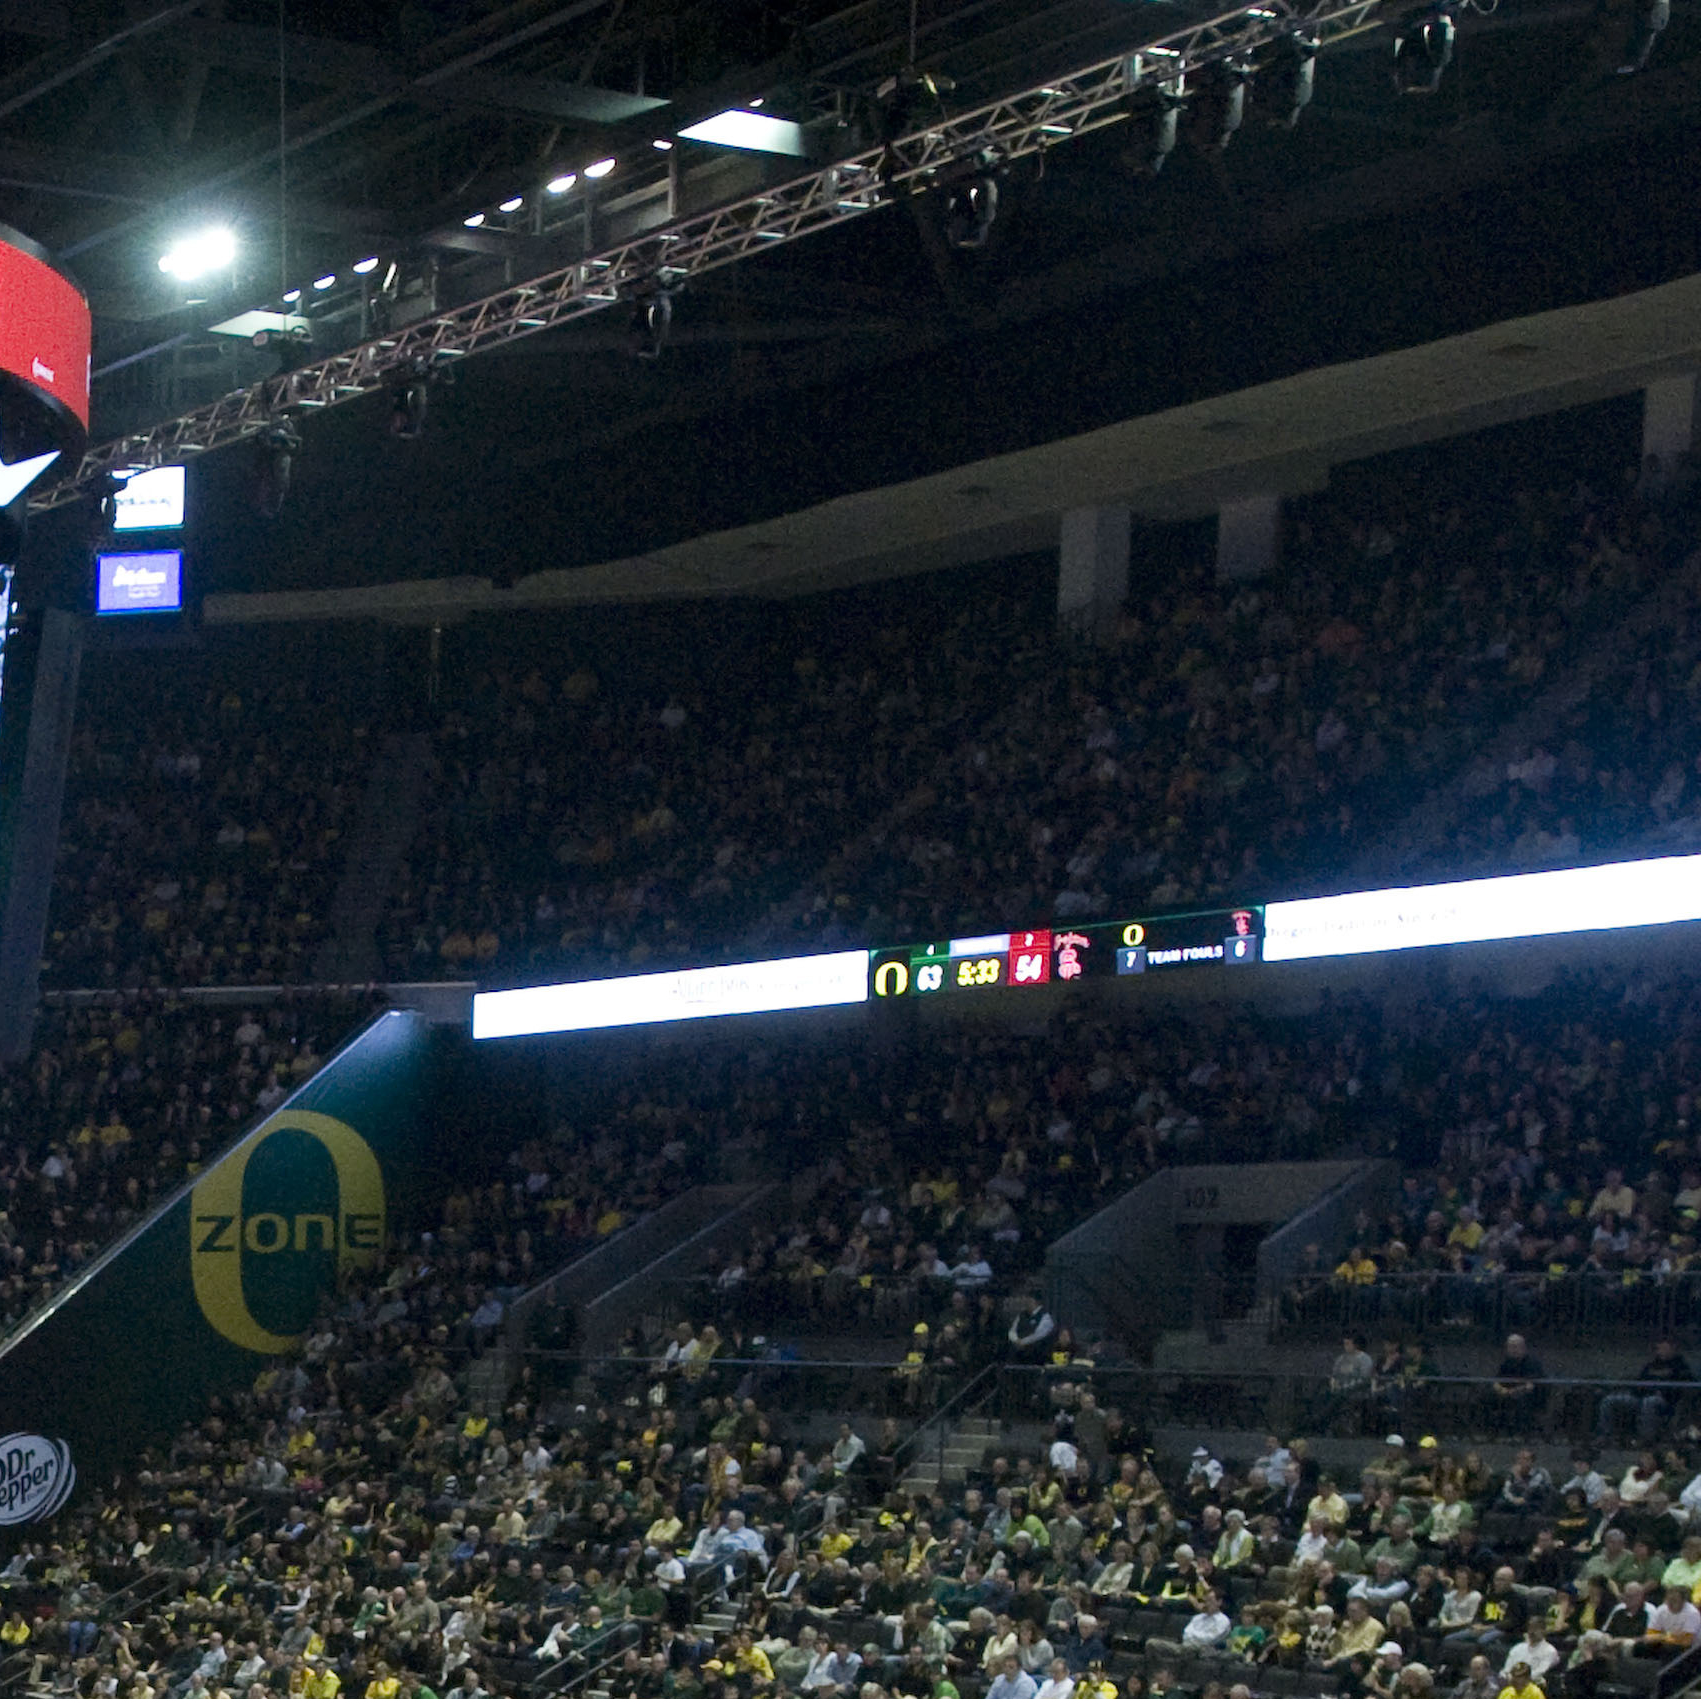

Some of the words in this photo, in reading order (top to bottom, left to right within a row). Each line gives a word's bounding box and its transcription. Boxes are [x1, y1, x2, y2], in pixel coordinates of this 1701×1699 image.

[1148, 949, 1182, 965] TEAM
[1182, 944, 1224, 962] FOULS
[7, 1448, 35, 1481] Dr
